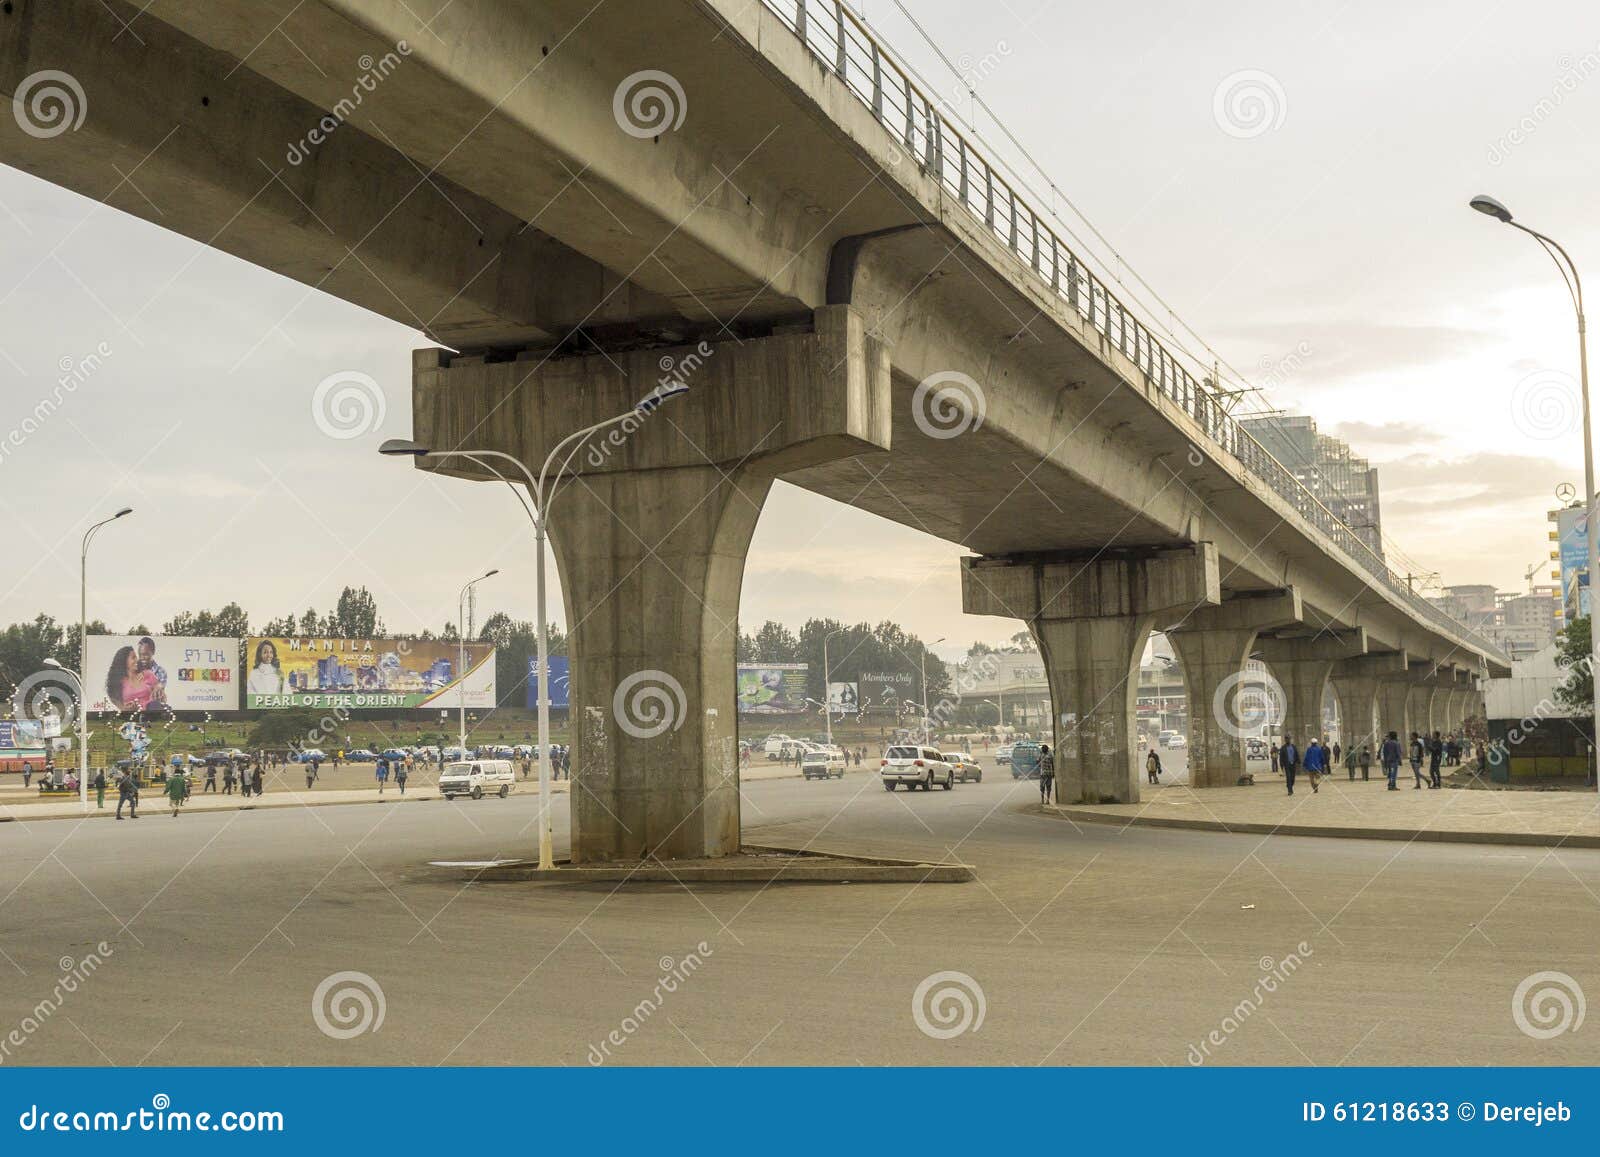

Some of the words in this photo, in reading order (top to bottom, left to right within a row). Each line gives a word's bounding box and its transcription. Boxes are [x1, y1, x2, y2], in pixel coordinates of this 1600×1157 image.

[289, 639, 374, 652] MANILA
[862, 671, 894, 682] Members
[895, 671, 912, 685] Only
[255, 695, 298, 707] PEARL
[302, 695, 321, 707] OF
[325, 695, 352, 706] THE
[355, 695, 406, 706] ORIENT
